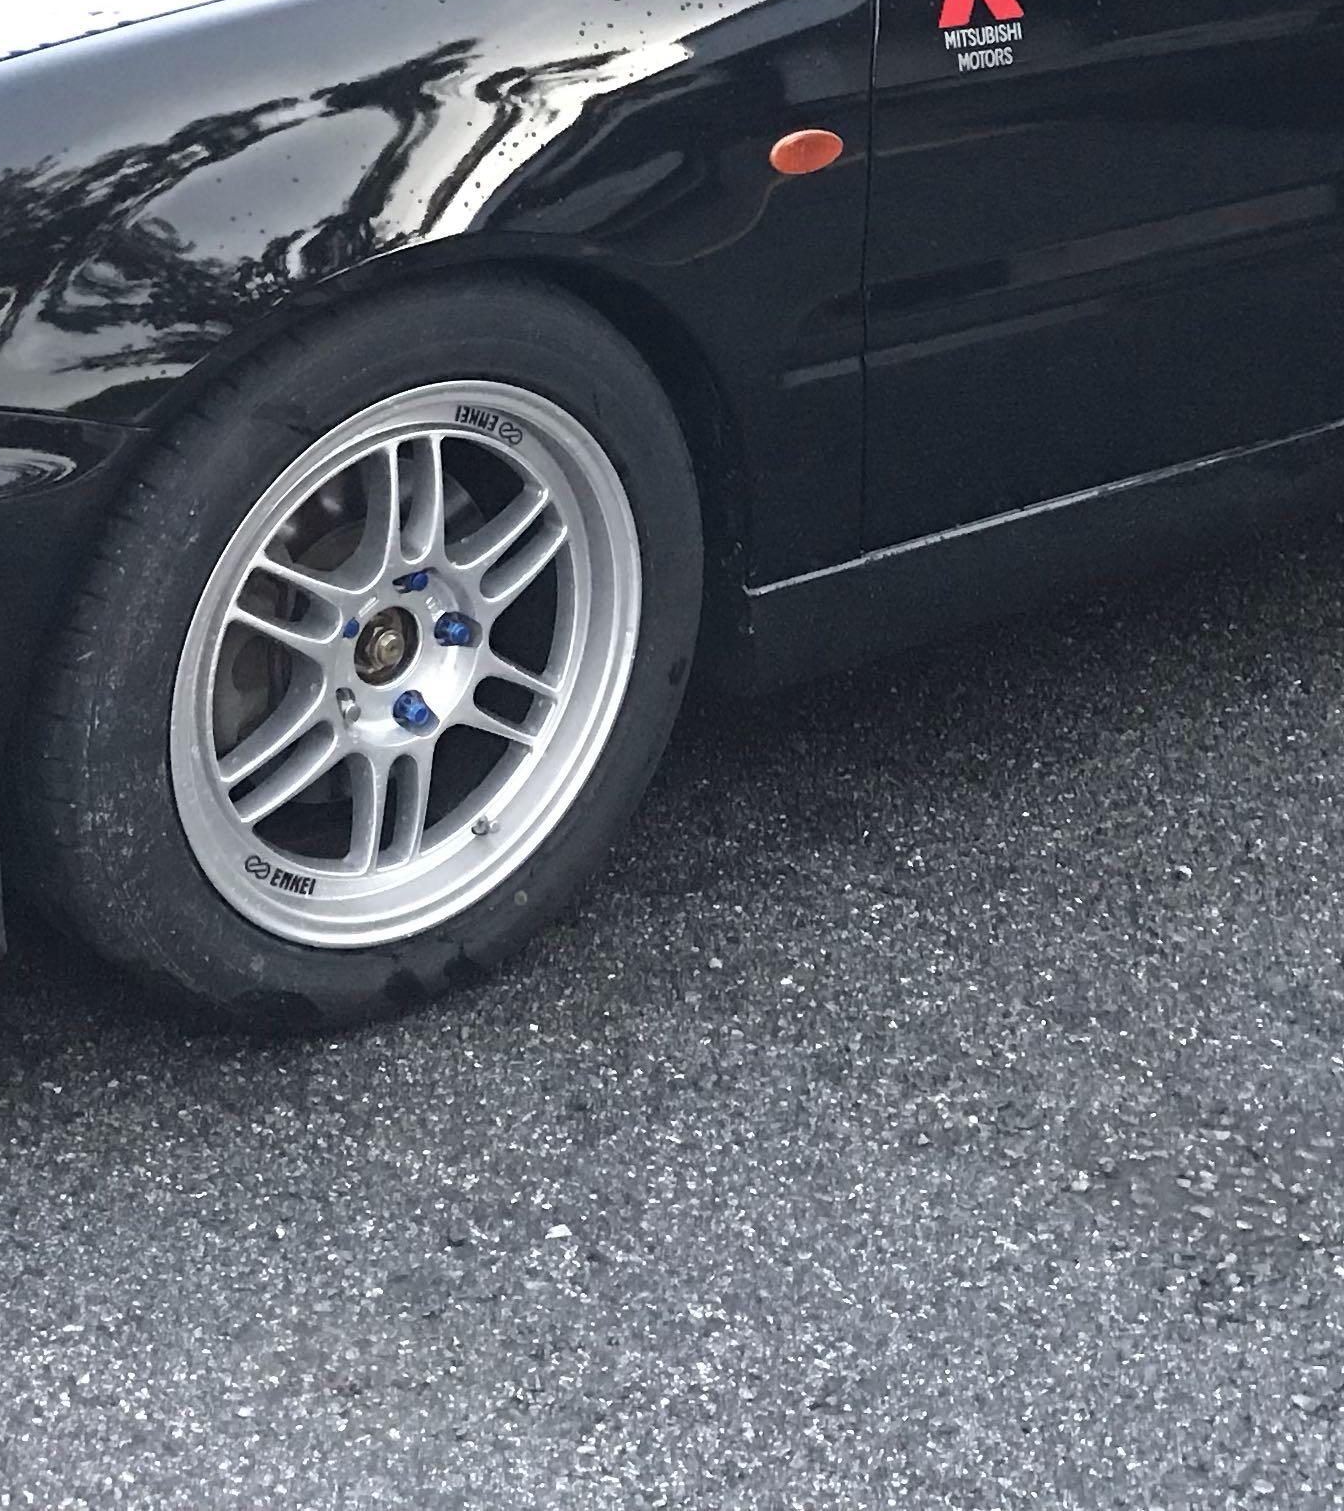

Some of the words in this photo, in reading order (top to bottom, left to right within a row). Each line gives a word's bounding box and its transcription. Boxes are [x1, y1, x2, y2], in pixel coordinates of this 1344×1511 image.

[943, 21, 1023, 50] MITSUBISHI
[957, 46, 1014, 72] MOTORS
[455, 404, 500, 432] ENKEI
[269, 867, 317, 896] ENKEI
